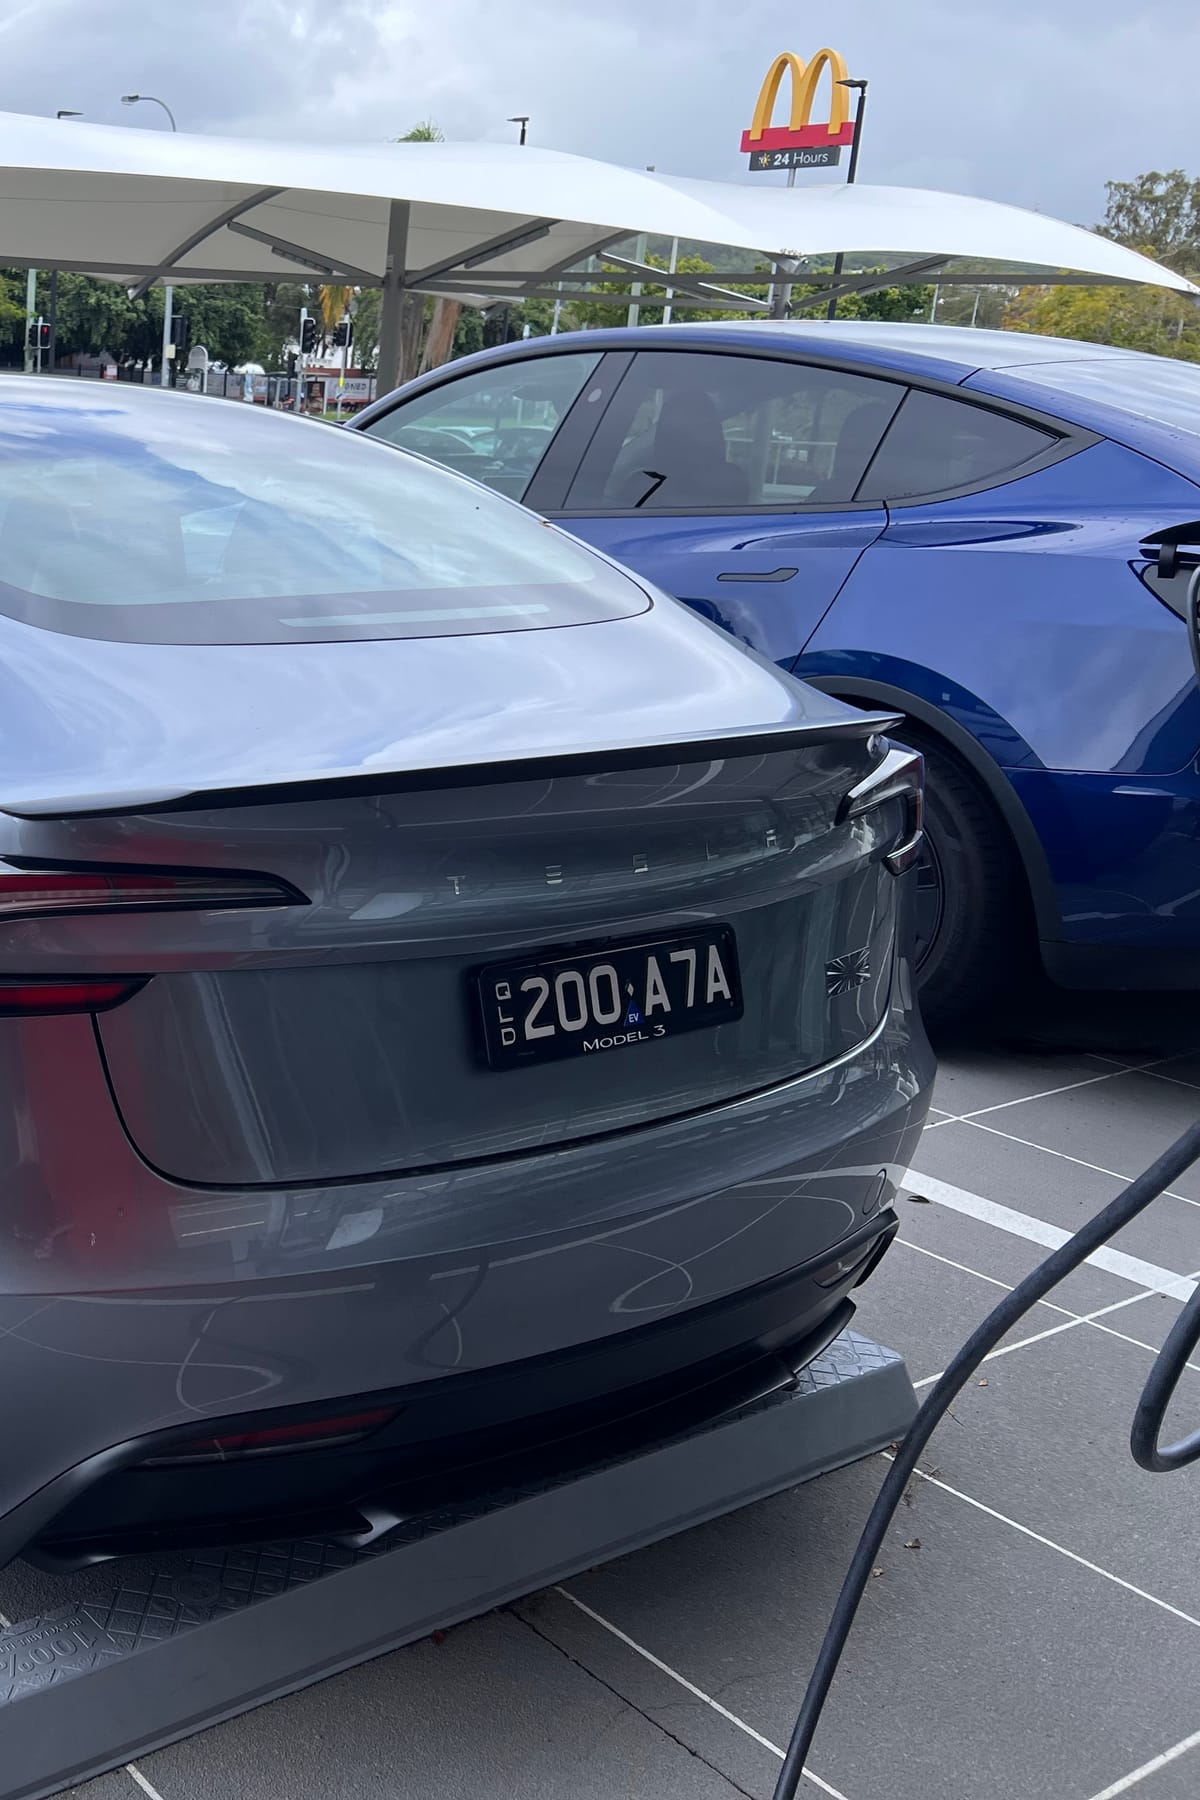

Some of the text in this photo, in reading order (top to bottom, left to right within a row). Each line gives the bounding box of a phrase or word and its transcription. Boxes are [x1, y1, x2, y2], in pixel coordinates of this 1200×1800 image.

[773, 151, 829, 166] 24 Hours
[495, 982, 516, 1046] QLD
[628, 1012, 640, 1023] EV
[583, 1024, 666, 1052] MODEL 3
